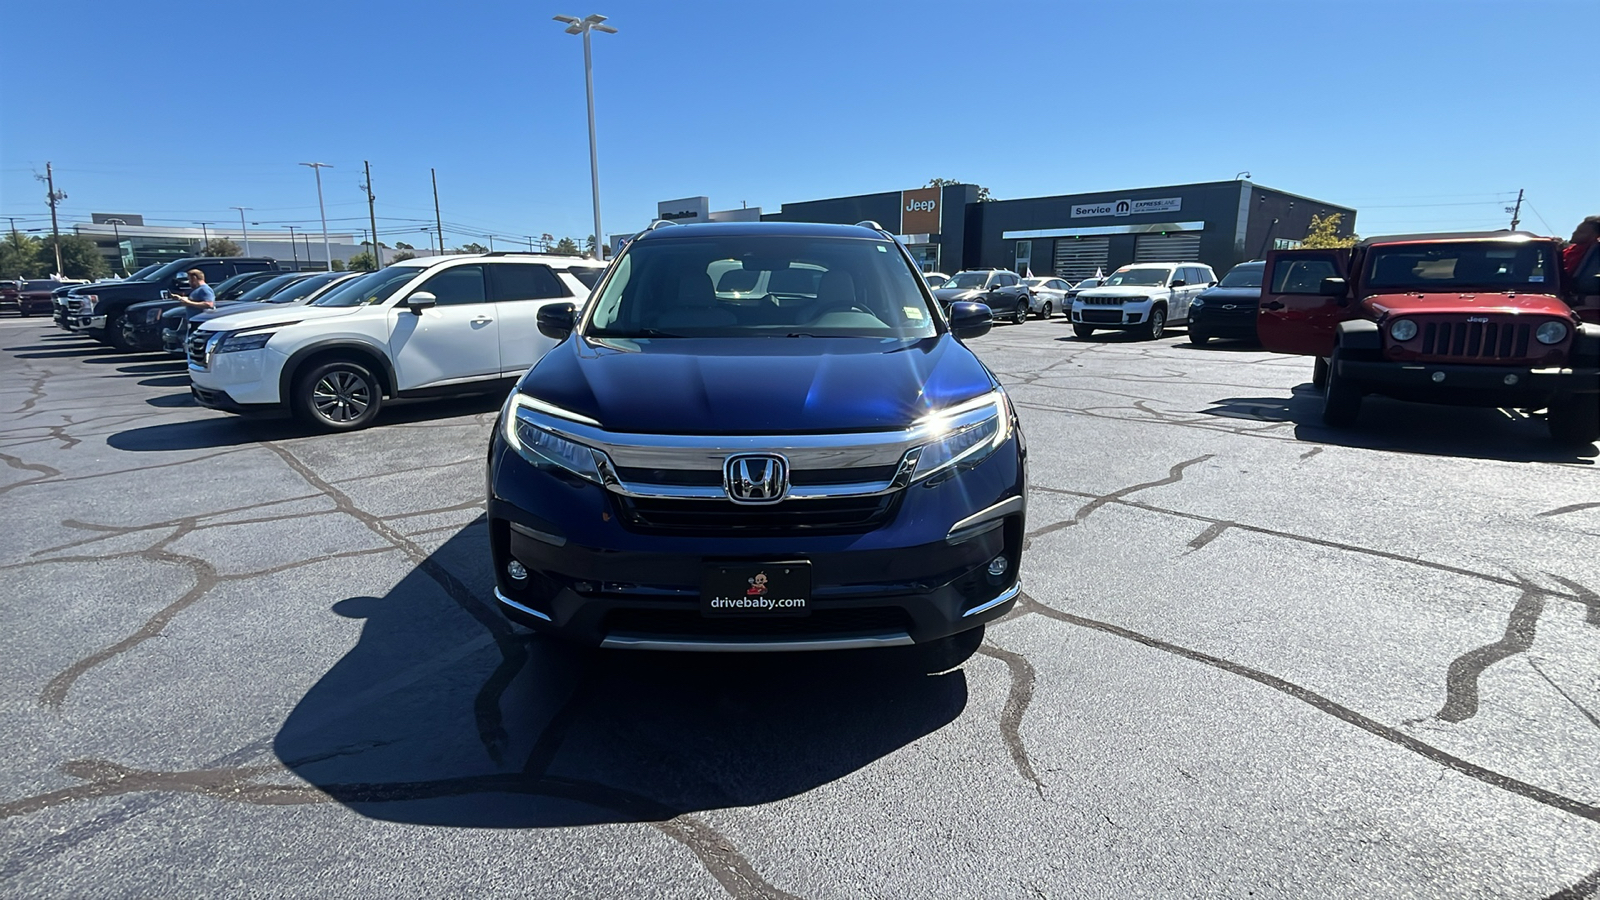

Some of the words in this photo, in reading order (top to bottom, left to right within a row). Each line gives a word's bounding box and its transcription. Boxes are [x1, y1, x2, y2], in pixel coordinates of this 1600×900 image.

[906, 199, 936, 213] Jeep
[1075, 206, 1111, 215] Service
[711, 597, 806, 610] drivebaby.com
